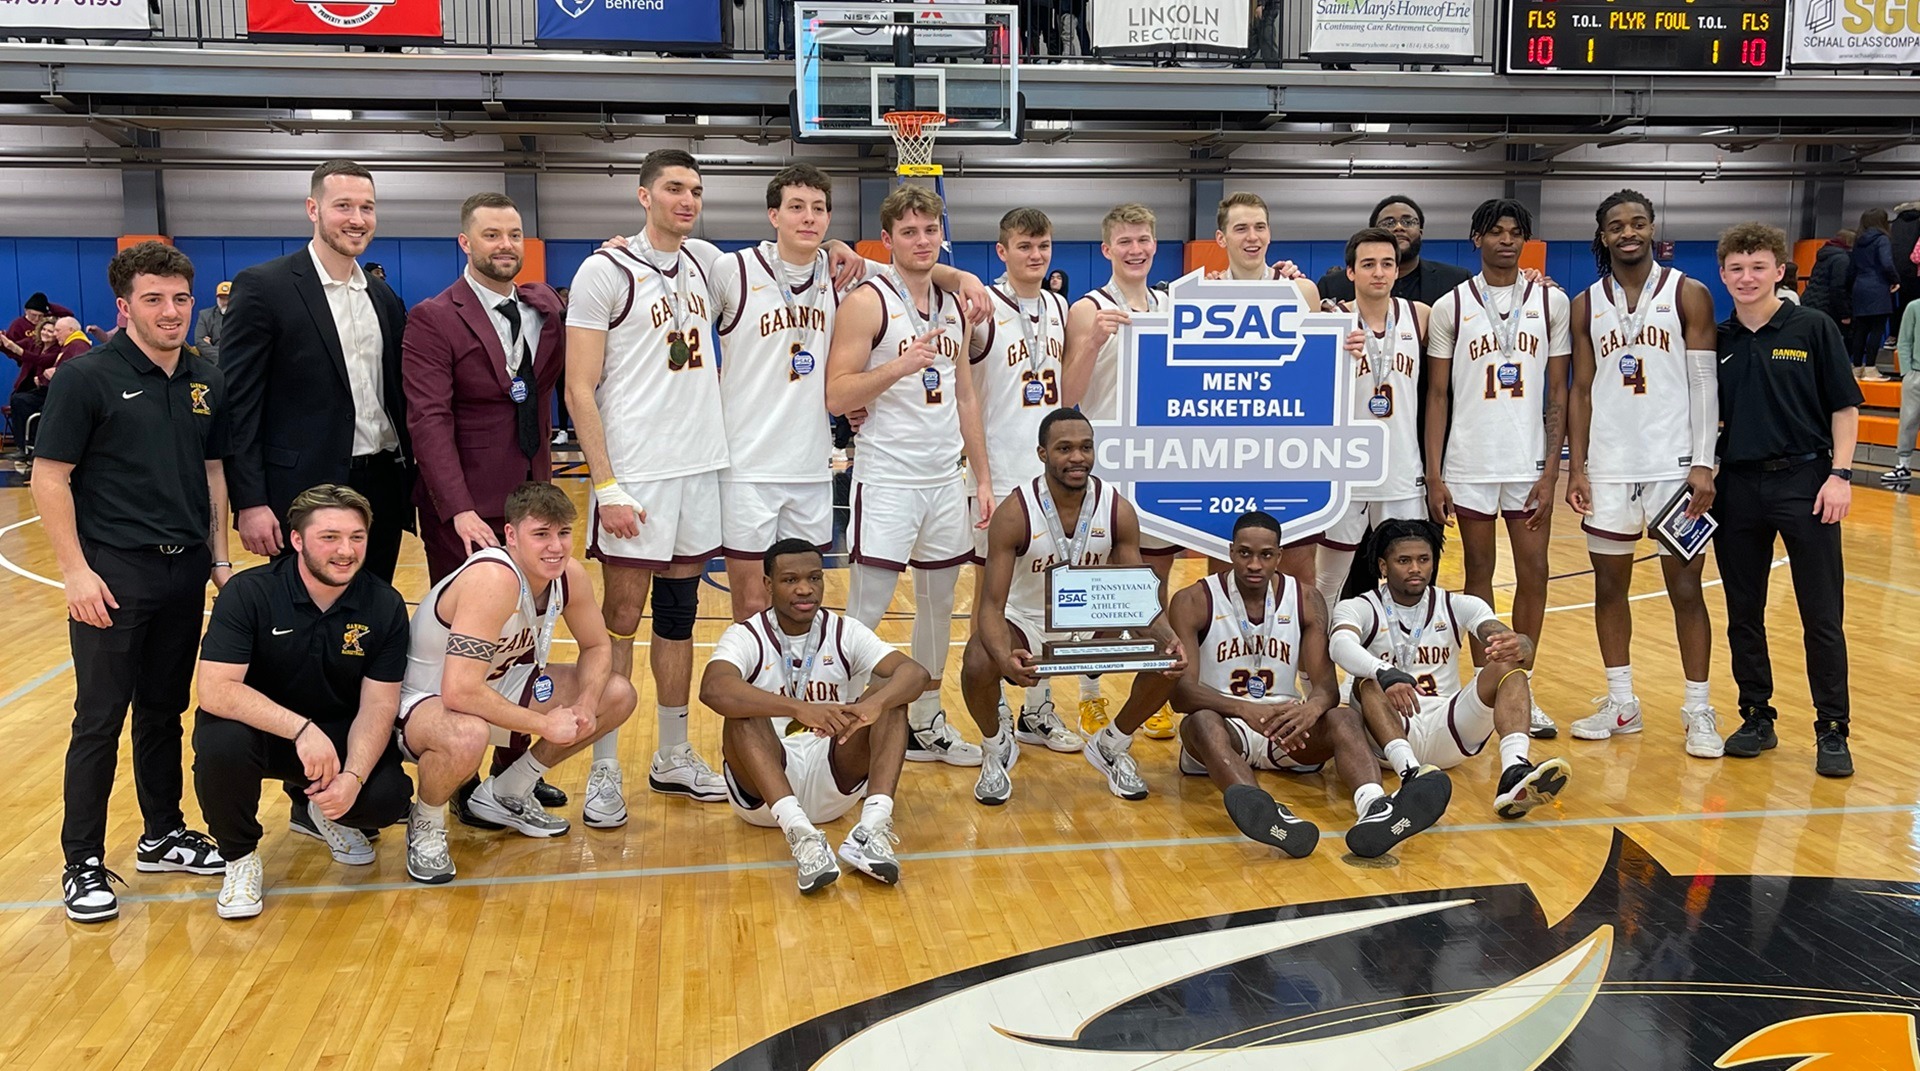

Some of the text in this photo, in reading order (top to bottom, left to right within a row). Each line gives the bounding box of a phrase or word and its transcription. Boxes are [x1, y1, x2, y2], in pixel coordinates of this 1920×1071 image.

[606, 0, 664, 10] Behrend
[1316, 0, 1470, 22] Saint Mary's Home of Erie
[1129, 5, 1218, 26] LINCOLN
[1528, 10, 1556, 29] FLS
[1572, 15, 1602, 27] T.O.L.
[1609, 11, 1691, 30] PLYR FOUL
[1698, 16, 1727, 29] T.O.L.
[1742, 13, 1769, 30] FLS
[1129, 27, 1218, 42] RECYCLING
[1324, 23, 1365, 32] Continuing
[1426, 24, 1470, 35] Community
[1528, 35, 1554, 65] 10
[1587, 37, 1594, 63] 1
[1804, 36, 1844, 47] SCHAAL
[1848, 36, 1882, 47] GLASS
[1712, 40, 1719, 64] 1
[1742, 38, 1766, 66] 10
[651, 292, 708, 328] GAON
[1174, 305, 1297, 338] PSAC
[1469, 331, 1538, 360] GAON
[1772, 348, 1808, 358] GANNON
[1203, 372, 1271, 391] MEN'S
[1484, 362, 1524, 399] 14
[1623, 358, 1646, 394] 4
[1167, 399, 1305, 417] BASKETBALL
[1098, 437, 1371, 470] CHAMPIONS
[1209, 497, 1257, 513] 2024
[1058, 594, 1087, 602] PSAC
[1217, 635, 1290, 665] GANNON
